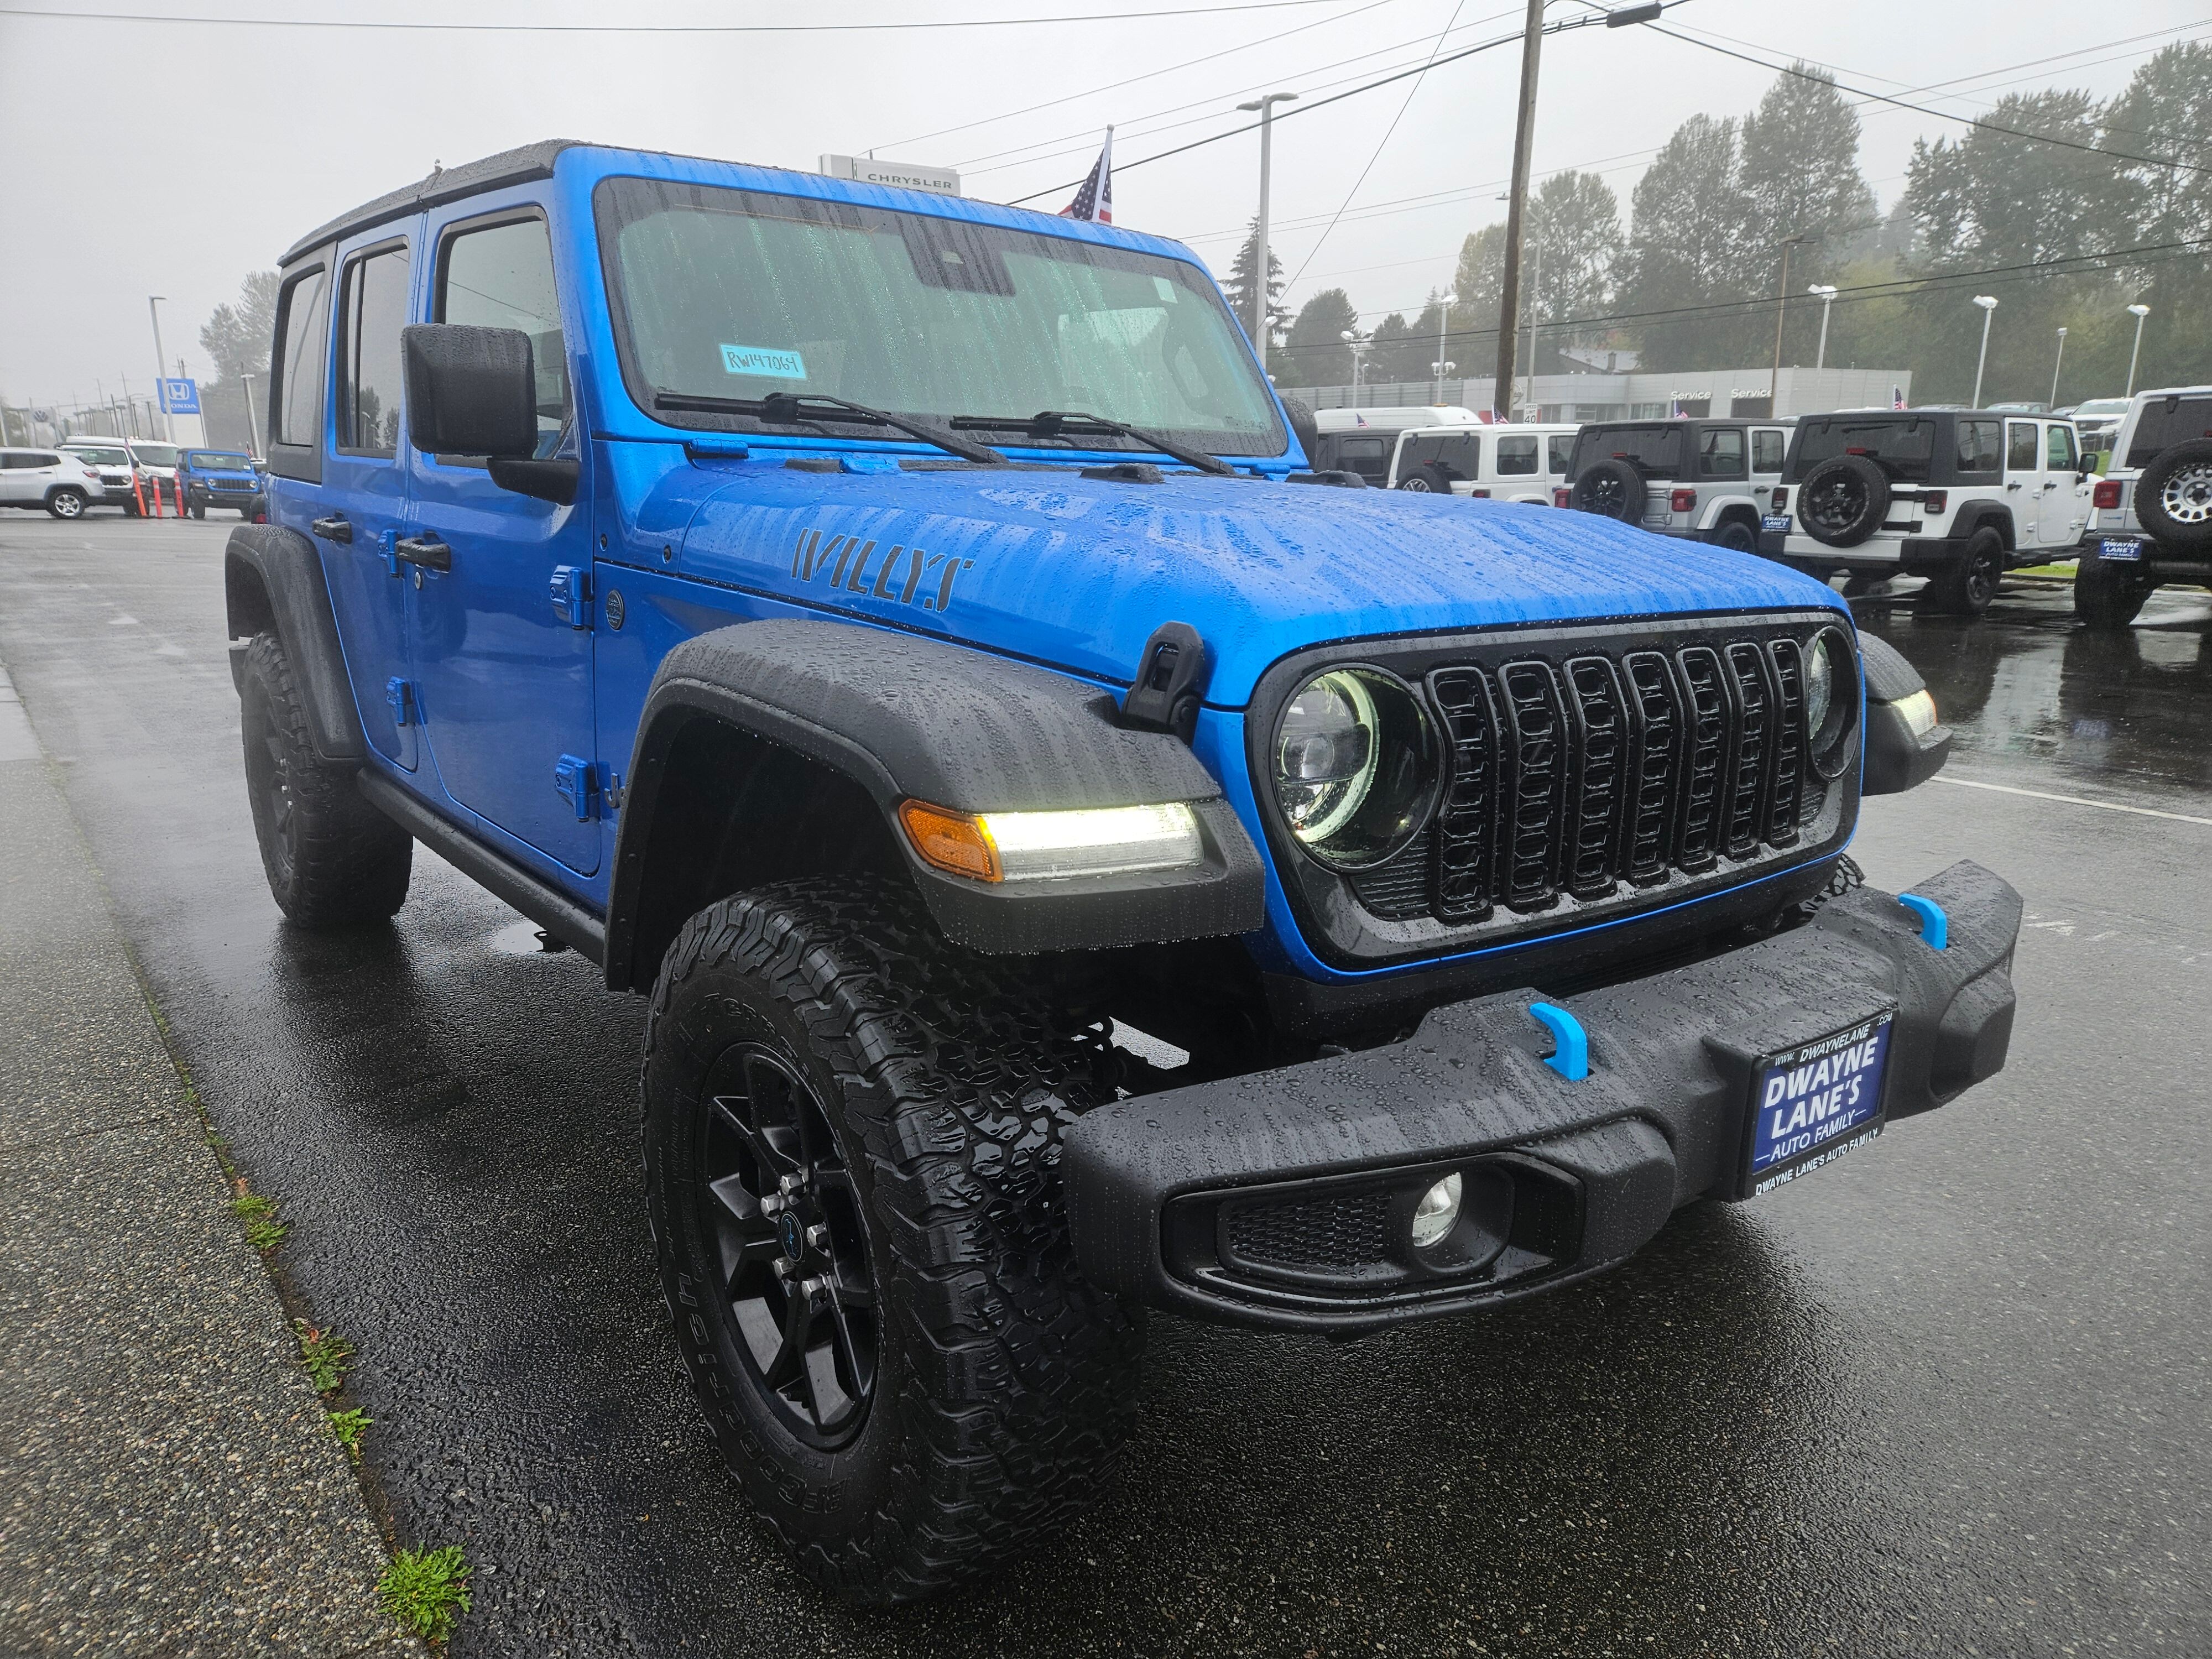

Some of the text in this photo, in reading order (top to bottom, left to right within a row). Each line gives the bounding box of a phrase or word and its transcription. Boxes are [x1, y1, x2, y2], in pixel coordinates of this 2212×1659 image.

[868, 173, 952, 189] CHRYSLER
[1524, 415, 1536, 424] 40
[1671, 390, 1712, 401] Service
[791, 528, 975, 613] WILLYS
[1799, 1024, 1871, 1062] DWAYNELANE
[1764, 1037, 1879, 1109] DWAYNE
[1771, 1075, 1862, 1140] LANE'S
[1755, 1128, 1879, 1196] DWAYNE LANE'S AUTO FAMILY
[1770, 1109, 1856, 1162] AUTO FAMILY
